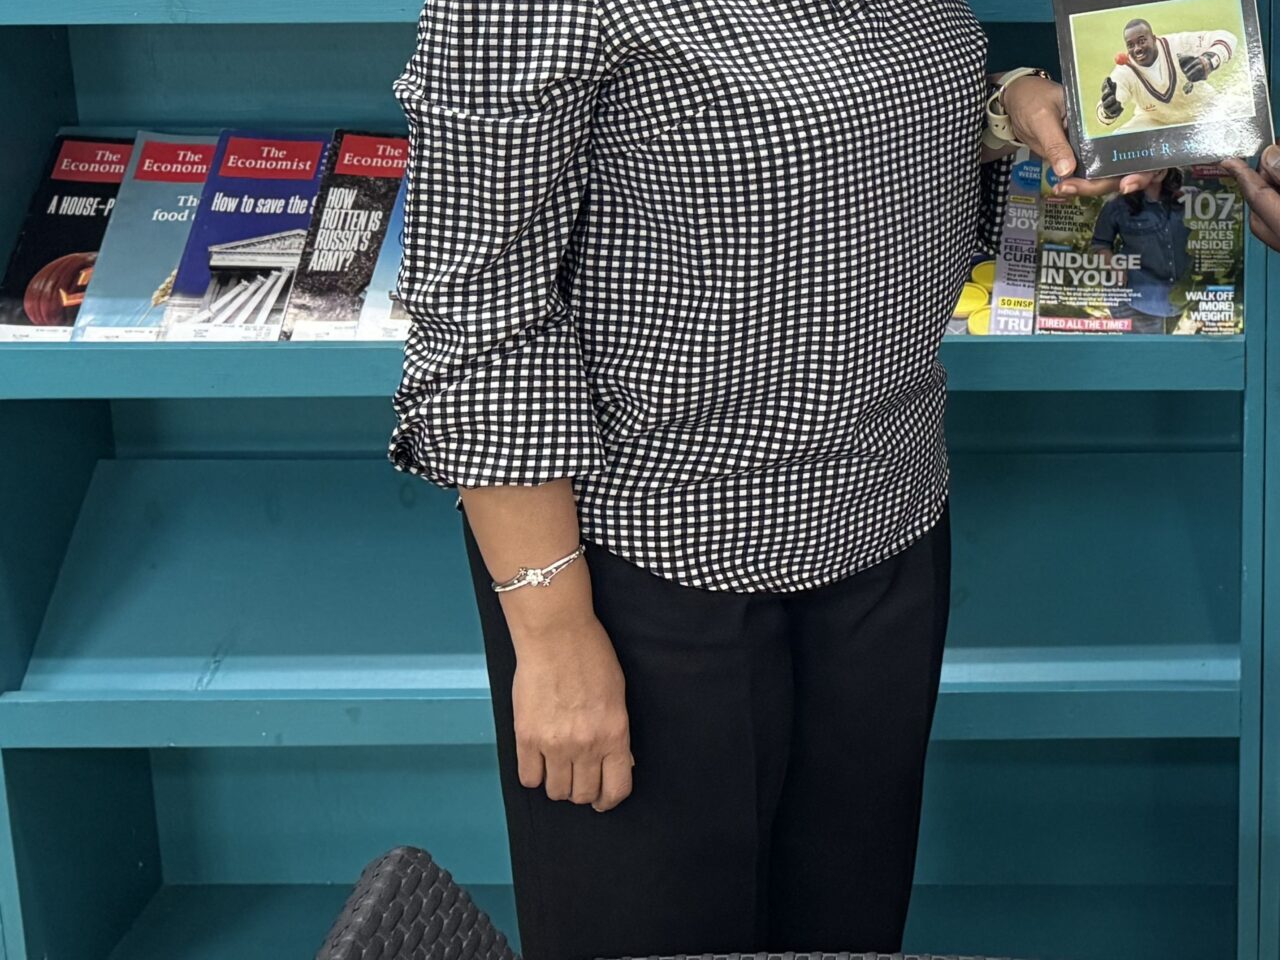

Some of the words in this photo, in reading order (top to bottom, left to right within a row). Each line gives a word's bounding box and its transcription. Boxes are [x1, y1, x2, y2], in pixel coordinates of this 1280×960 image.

[95, 150, 122, 163] The
[177, 150, 202, 162] The
[260, 147, 287, 159] The
[376, 144, 403, 157] The
[1111, 147, 1156, 162] Junior
[227, 155, 311, 171] Economist
[211, 192, 237, 212] How
[241, 195, 254, 212] to
[256, 199, 285, 213] save
[288, 196, 307, 214] the
[325, 187, 357, 209] HOW
[47, 198, 59, 214] A
[1177, 192, 1236, 220] 107
[152, 210, 188, 222] food
[319, 209, 366, 231] ROTTEN
[367, 211, 383, 231] IS
[1006, 217, 1039, 230] JOY
[1043, 225, 1073, 233] WOMEN
[1190, 221, 1235, 230] SMART
[314, 229, 371, 250] RUSSIA'S
[1199, 230, 1234, 240] FIXES
[1188, 240, 1234, 249] INSIDE!
[308, 250, 355, 272] ARMY?
[1042, 250, 1141, 270] INDULGE
[1040, 268, 1064, 284] IN
[1068, 270, 1123, 287] YOU!
[1001, 298, 1012, 307] SO
[1185, 291, 1216, 301] WALK
[1217, 291, 1235, 301] OFF
[1199, 301, 1235, 311] (MORE)
[1190, 311, 1234, 321] WEIGHT!
[1041, 319, 1065, 328] TIRED
[1067, 320, 1083, 328] ALL
[1085, 320, 1102, 329] THE
[1103, 320, 1129, 330] TIME?
